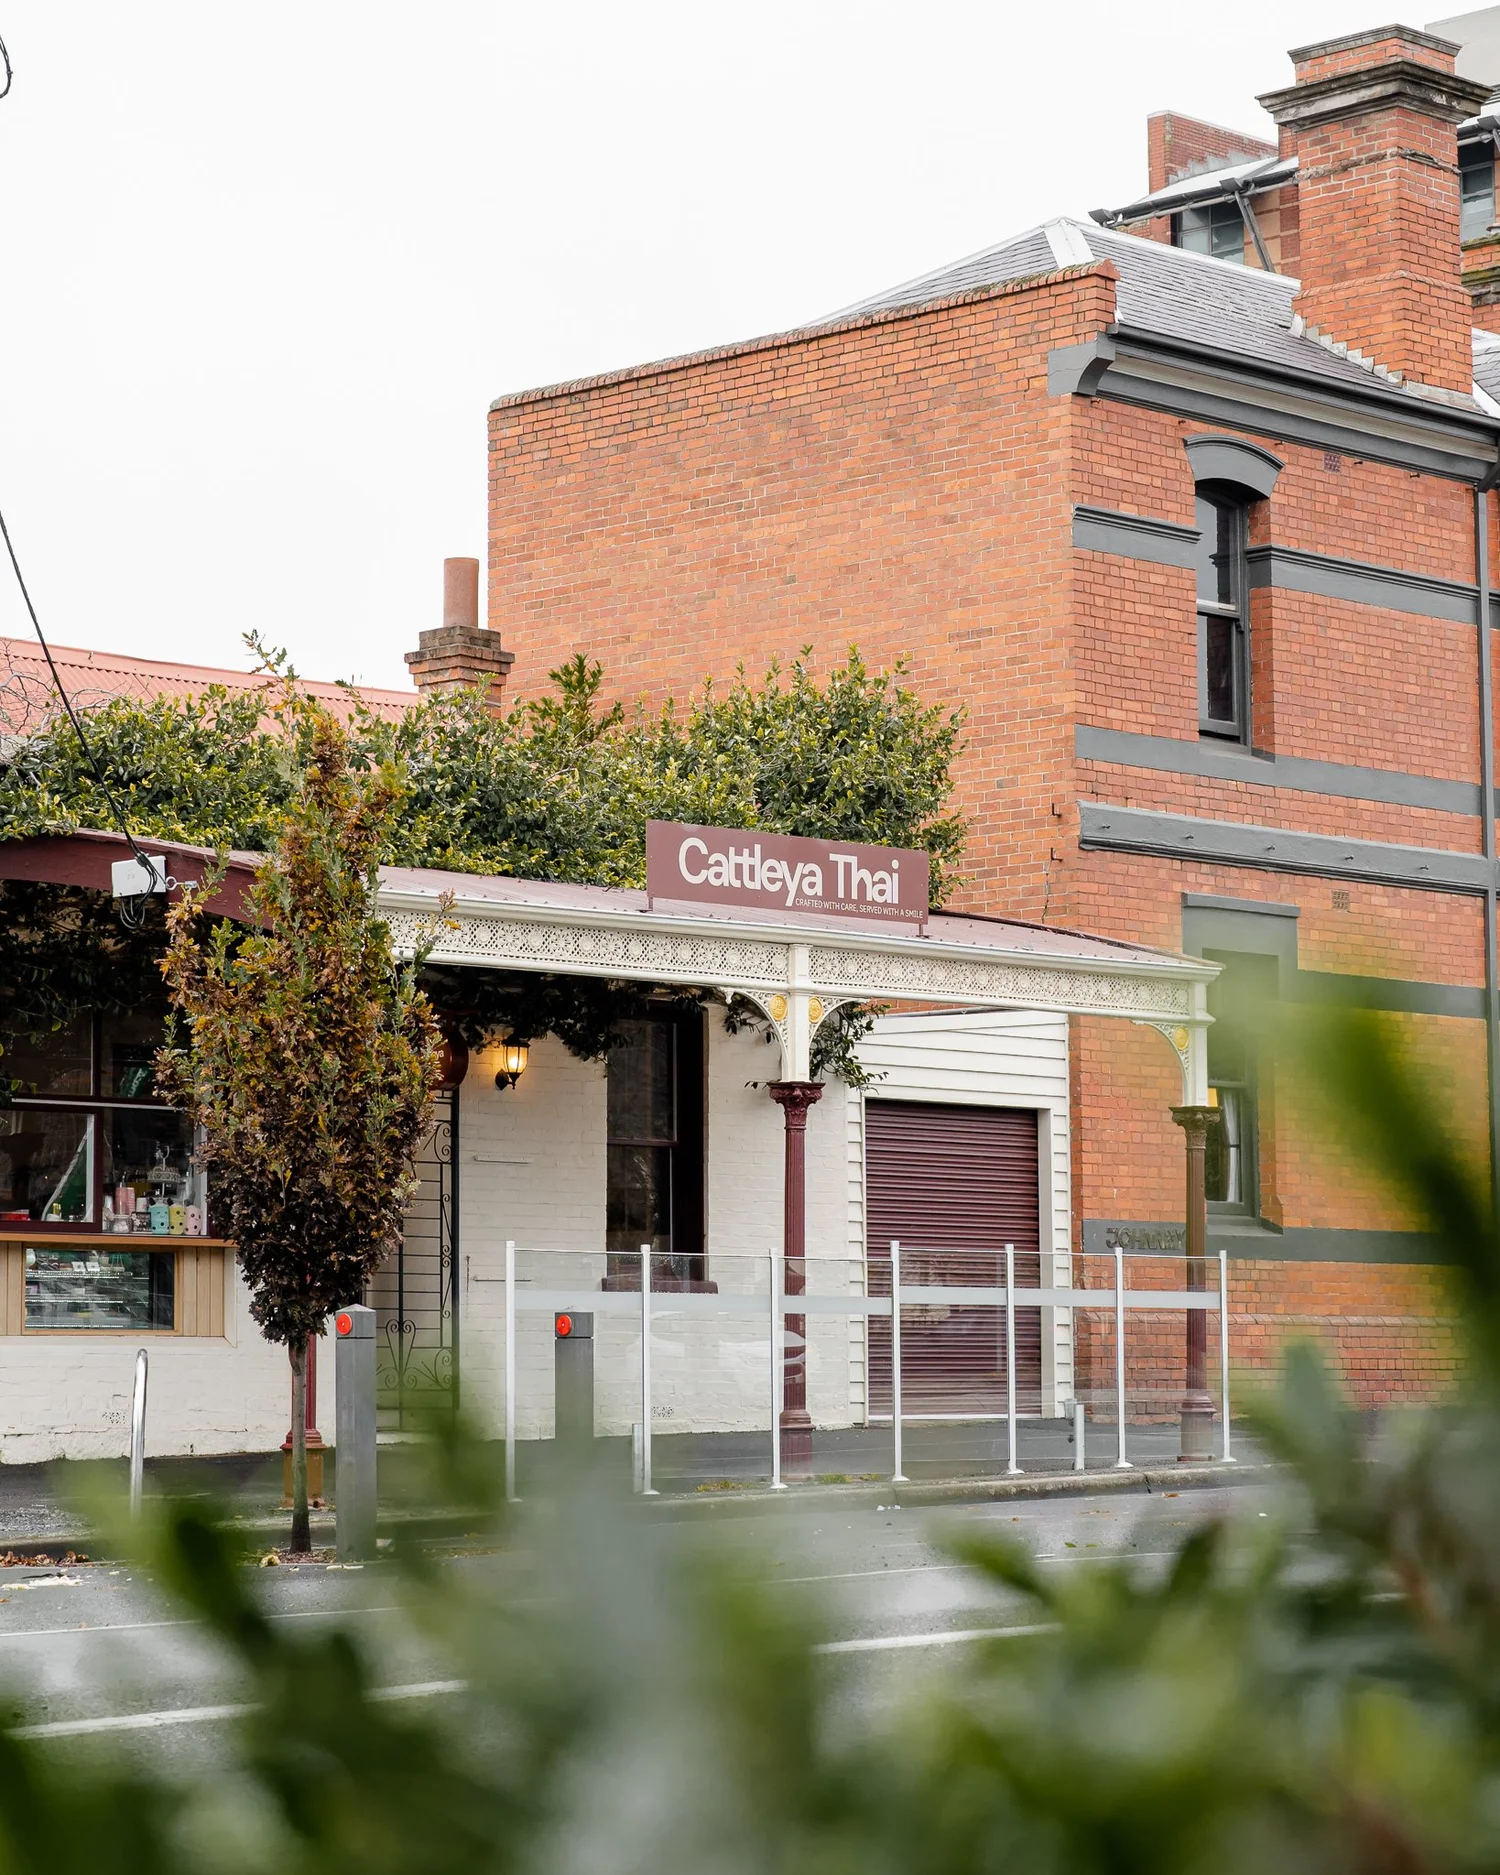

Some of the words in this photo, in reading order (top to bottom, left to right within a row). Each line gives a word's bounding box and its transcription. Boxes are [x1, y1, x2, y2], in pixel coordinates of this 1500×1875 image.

[679, 837, 823, 907] Cattleya
[829, 853, 900, 904] Thai
[795, 898, 823, 908] CRAFTED
[823, 901, 840, 910] WITH
[841, 903, 858, 913] CARE,
[859, 905, 882, 915] SERVED
[882, 907, 899, 916] WITH
[905, 910, 923, 919] SMILE
